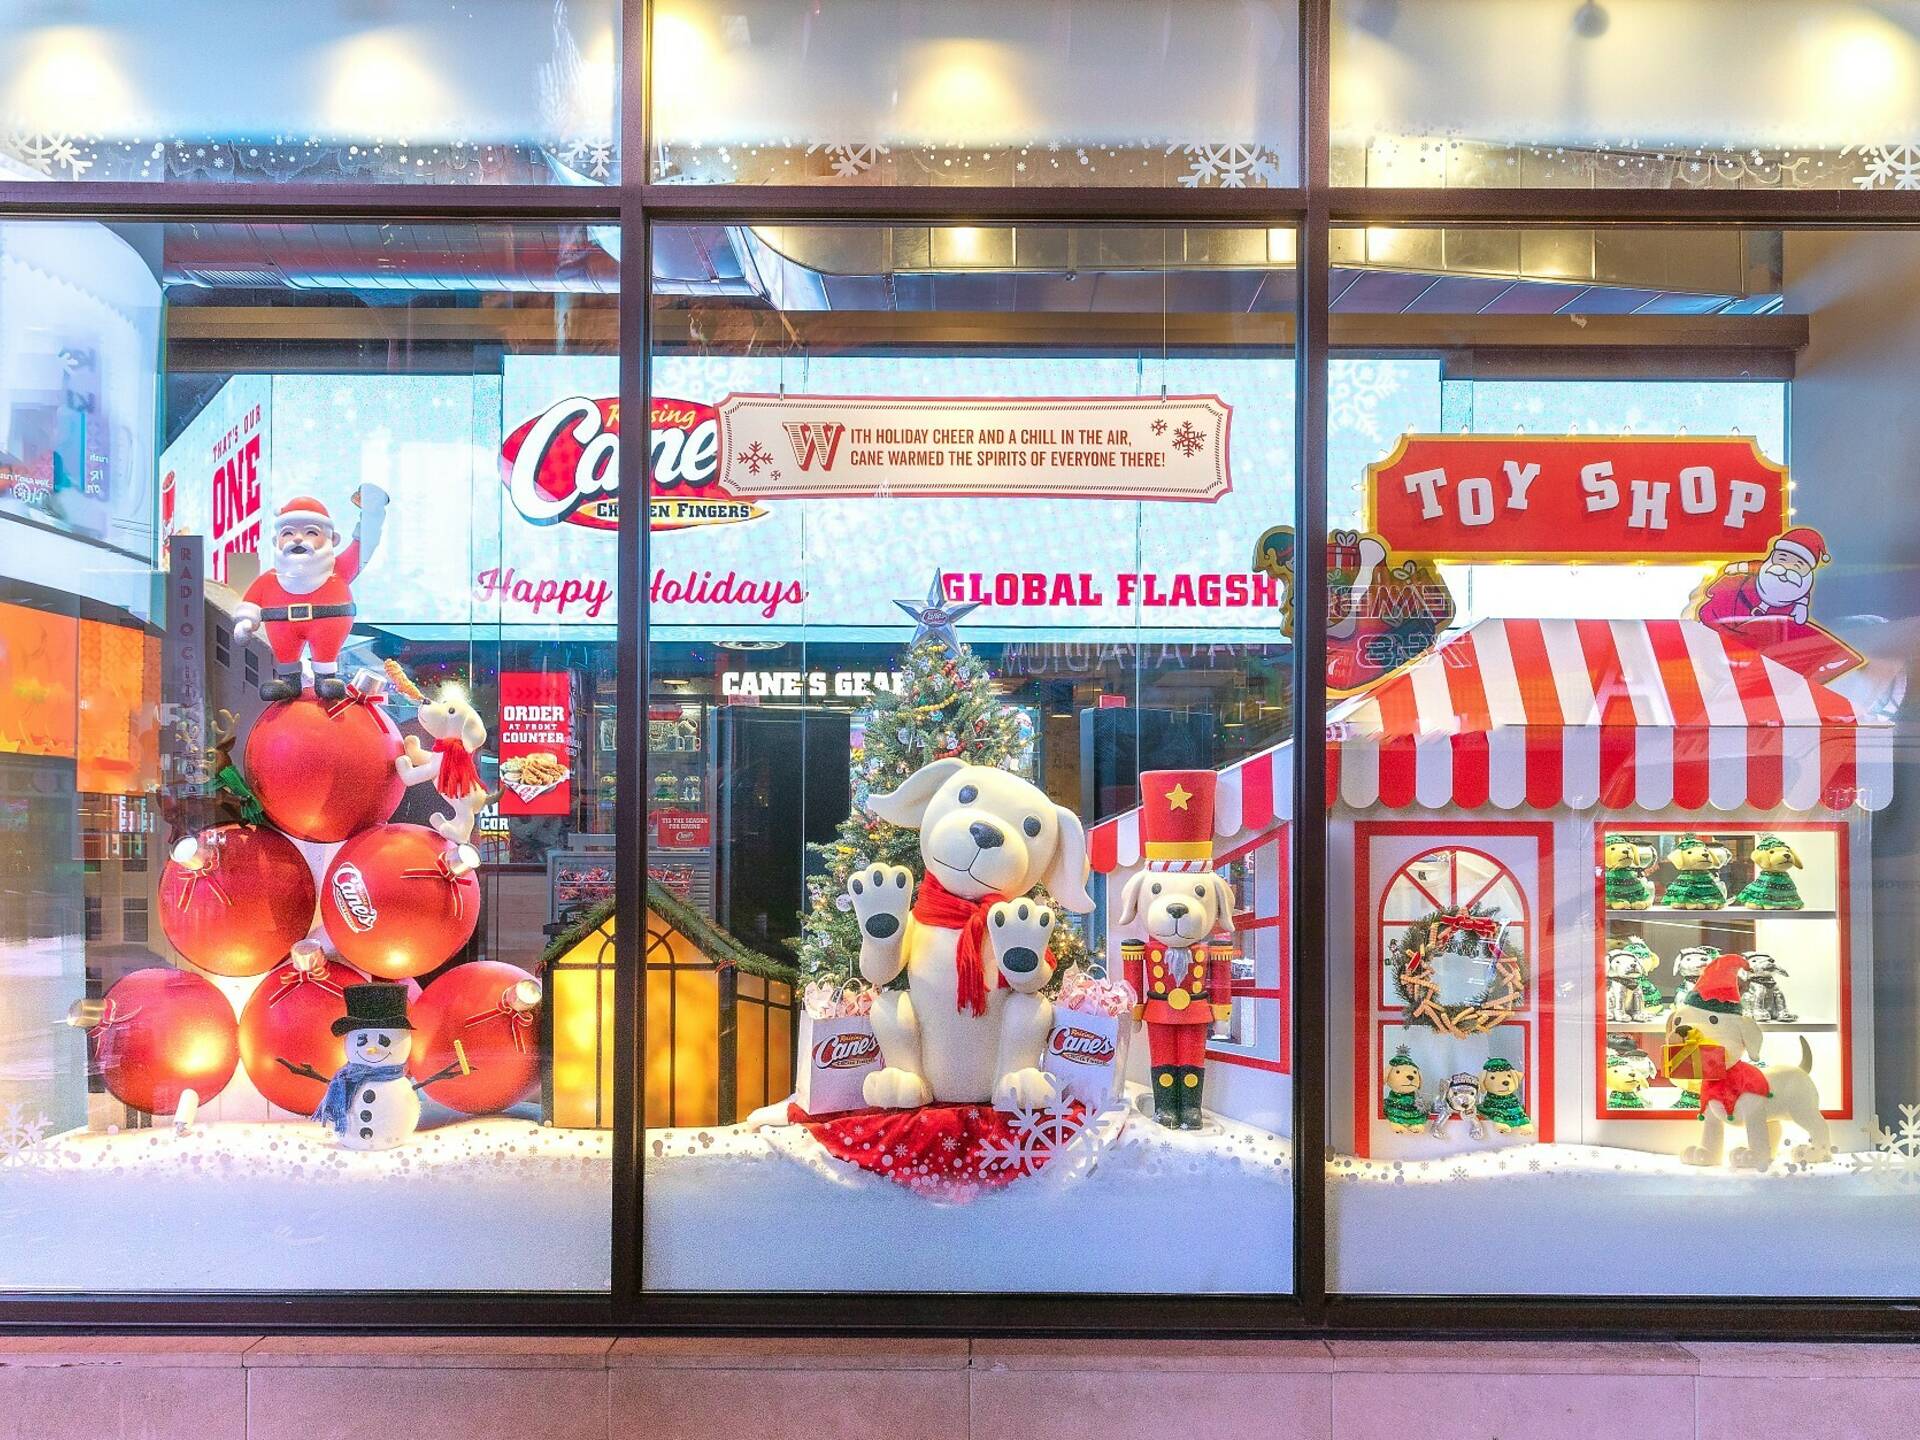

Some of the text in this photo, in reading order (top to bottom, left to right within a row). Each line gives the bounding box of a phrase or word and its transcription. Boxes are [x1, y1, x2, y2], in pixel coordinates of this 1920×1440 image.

[606, 404, 696, 430] Rsing
[212, 403, 262, 464] THAT'S OUR
[876, 428, 928, 444] HOLIDAY
[933, 428, 974, 444] CHEER
[978, 429, 1004, 444] AND
[1008, 429, 1017, 445] A
[1021, 429, 1056, 445] CHILL
[1061, 429, 1074, 445] IN
[1079, 429, 1103, 445] THE
[1107, 429, 1132, 447] AIR,
[510, 396, 718, 524] Cane
[850, 450, 1166, 467] CANE WARMED THE SPIRITS OF EVERYONE THERE!
[212, 433, 261, 532] ONE
[1404, 460, 1767, 530] TOY SHOP
[596, 502, 750, 518] CHEN FINGERS
[473, 567, 613, 618] Happy
[942, 572, 1279, 607] GLOBAL FLAGSH
[722, 671, 827, 696] CANE'S
[503, 705, 565, 722] ORDER
[508, 723, 558, 731] AT FRONT
[502, 732, 565, 743] COUNTER
[332, 866, 377, 926] Cane's
[815, 1031, 880, 1069] Cane's
[1048, 1024, 1115, 1056] Cane's
